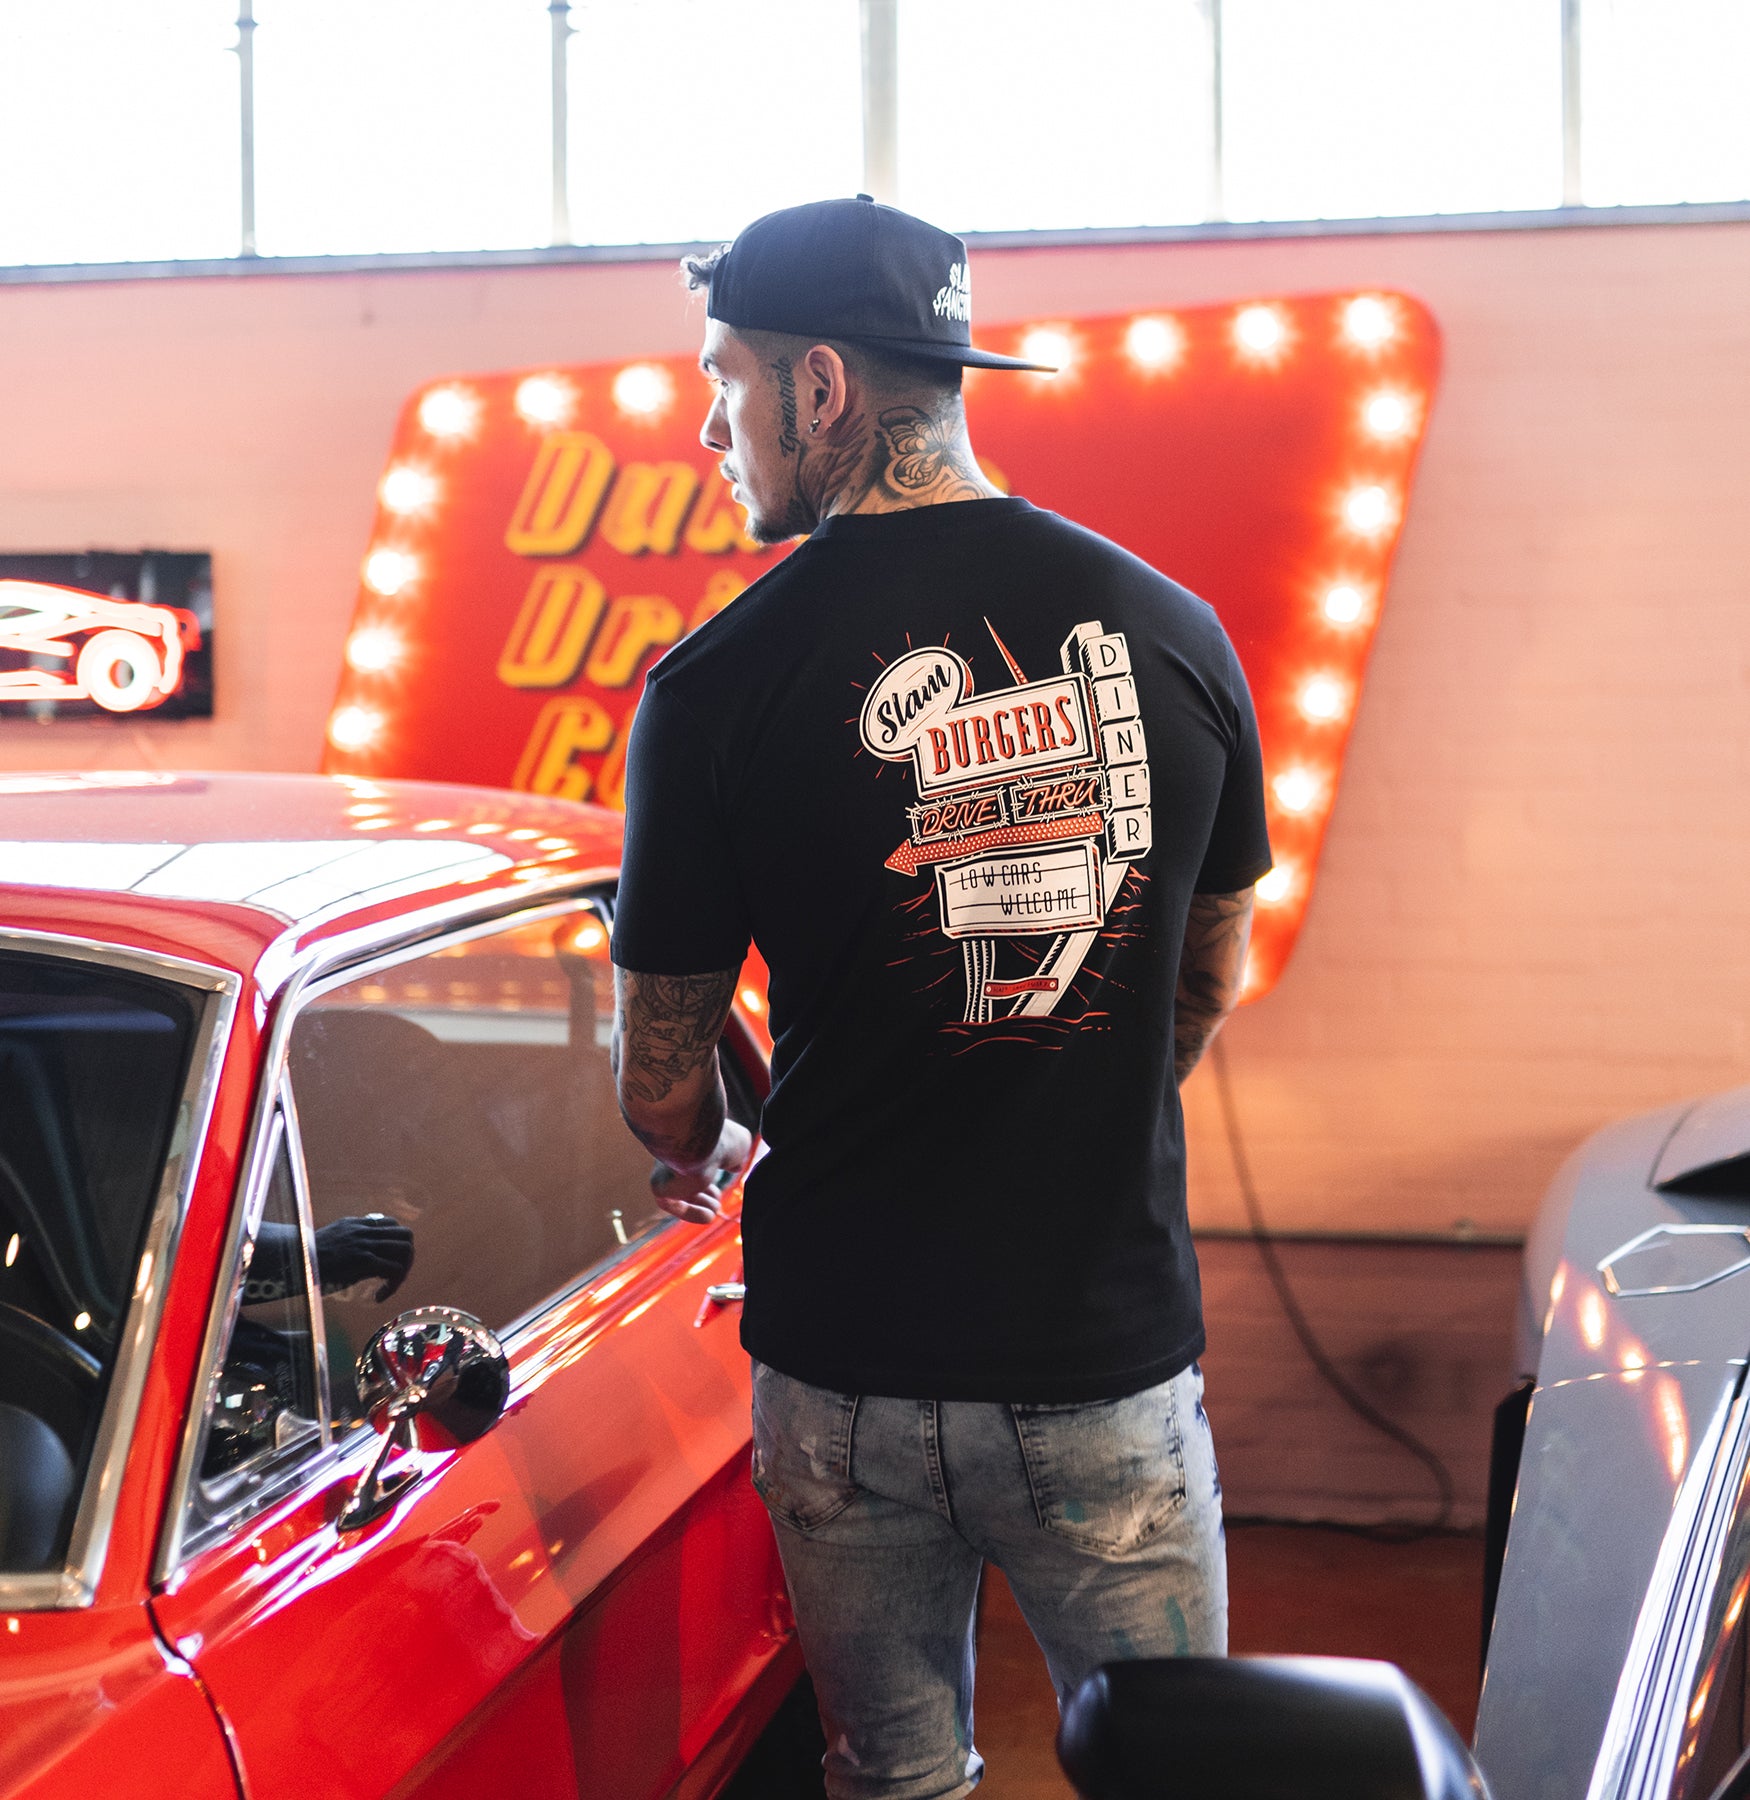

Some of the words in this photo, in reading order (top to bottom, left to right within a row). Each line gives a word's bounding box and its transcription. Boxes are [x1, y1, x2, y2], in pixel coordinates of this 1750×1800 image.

[877, 664, 951, 744] Slam
[925, 695, 1077, 776] BURGERS
[1101, 644, 1140, 841] DINER
[922, 796, 999, 836] DRIVE
[1022, 778, 1098, 815] THRU
[961, 865, 995, 891] LOW
[1002, 861, 1043, 887] CARS
[1000, 887, 1077, 916] WELCOME
